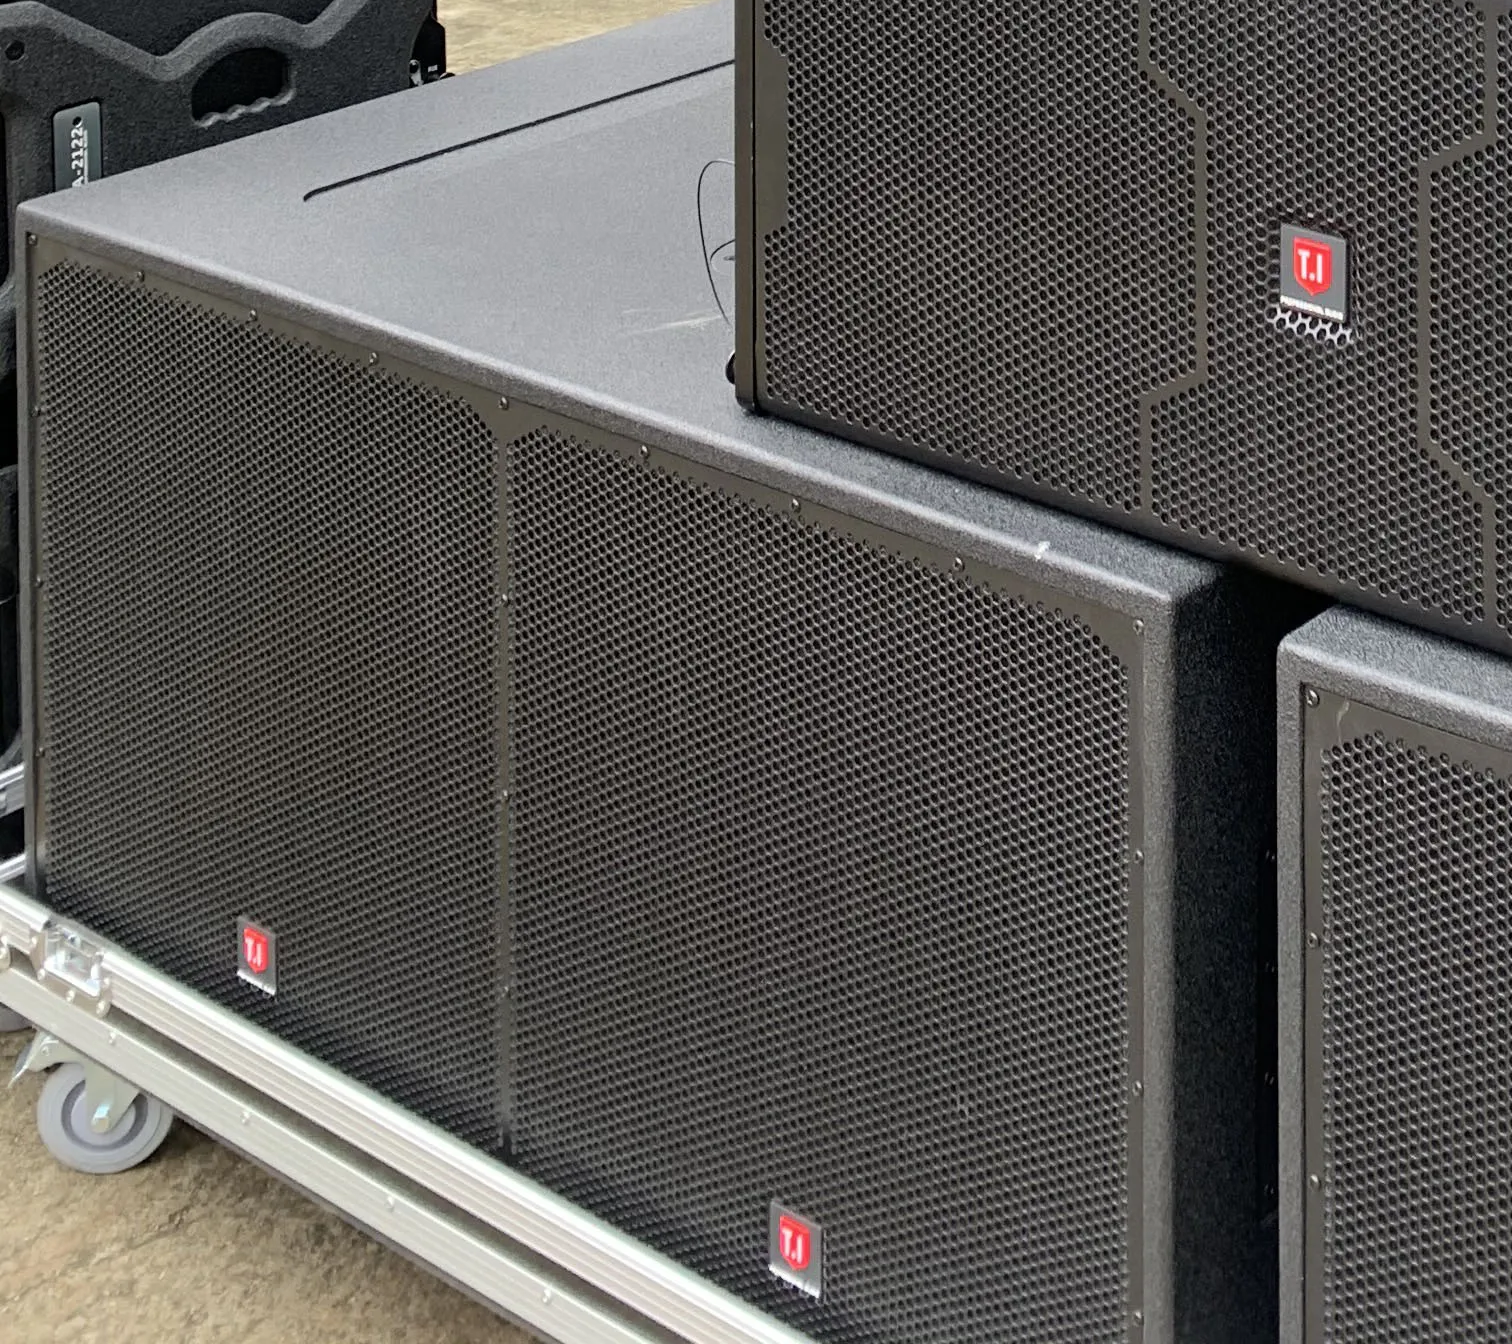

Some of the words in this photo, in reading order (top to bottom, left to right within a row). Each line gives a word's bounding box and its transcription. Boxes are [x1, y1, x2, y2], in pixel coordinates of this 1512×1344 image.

[1297, 248, 1323, 284] T.I
[244, 937, 263, 968] T.I
[781, 1227, 803, 1265] T.I
